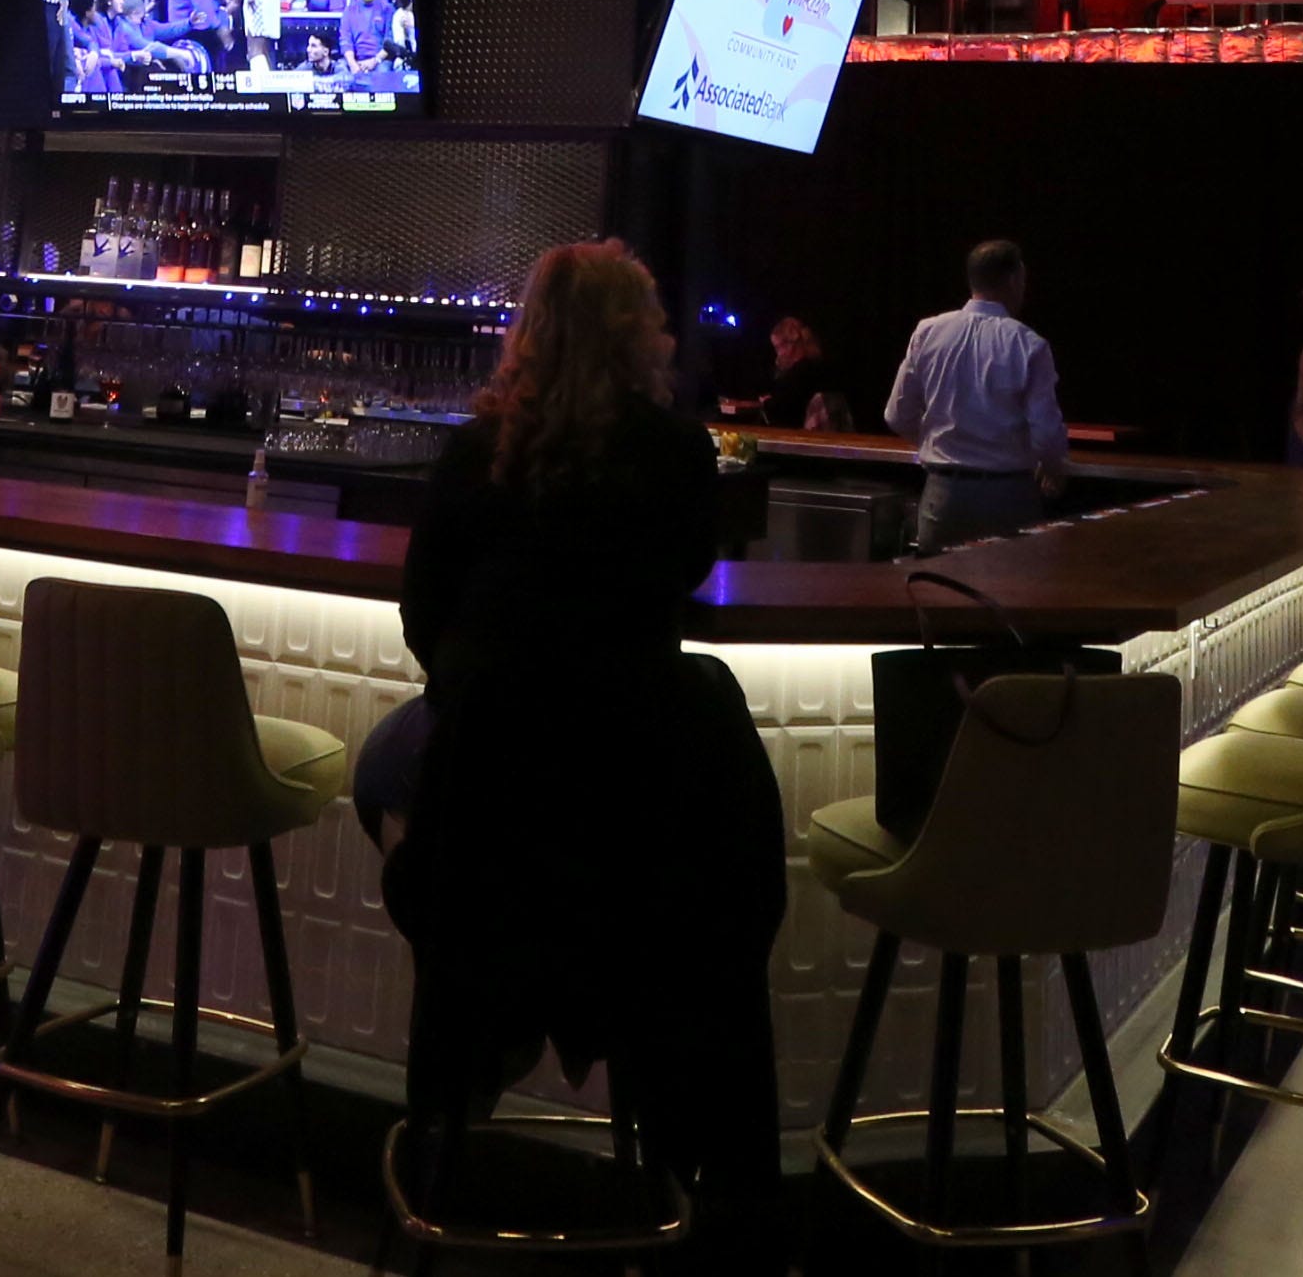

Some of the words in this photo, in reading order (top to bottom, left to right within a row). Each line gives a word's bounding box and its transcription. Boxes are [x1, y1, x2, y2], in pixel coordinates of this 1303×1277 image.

[727, 37, 776, 64] COMMUNITY
[778, 51, 799, 71] FUND
[146, 93, 164, 103] policy
